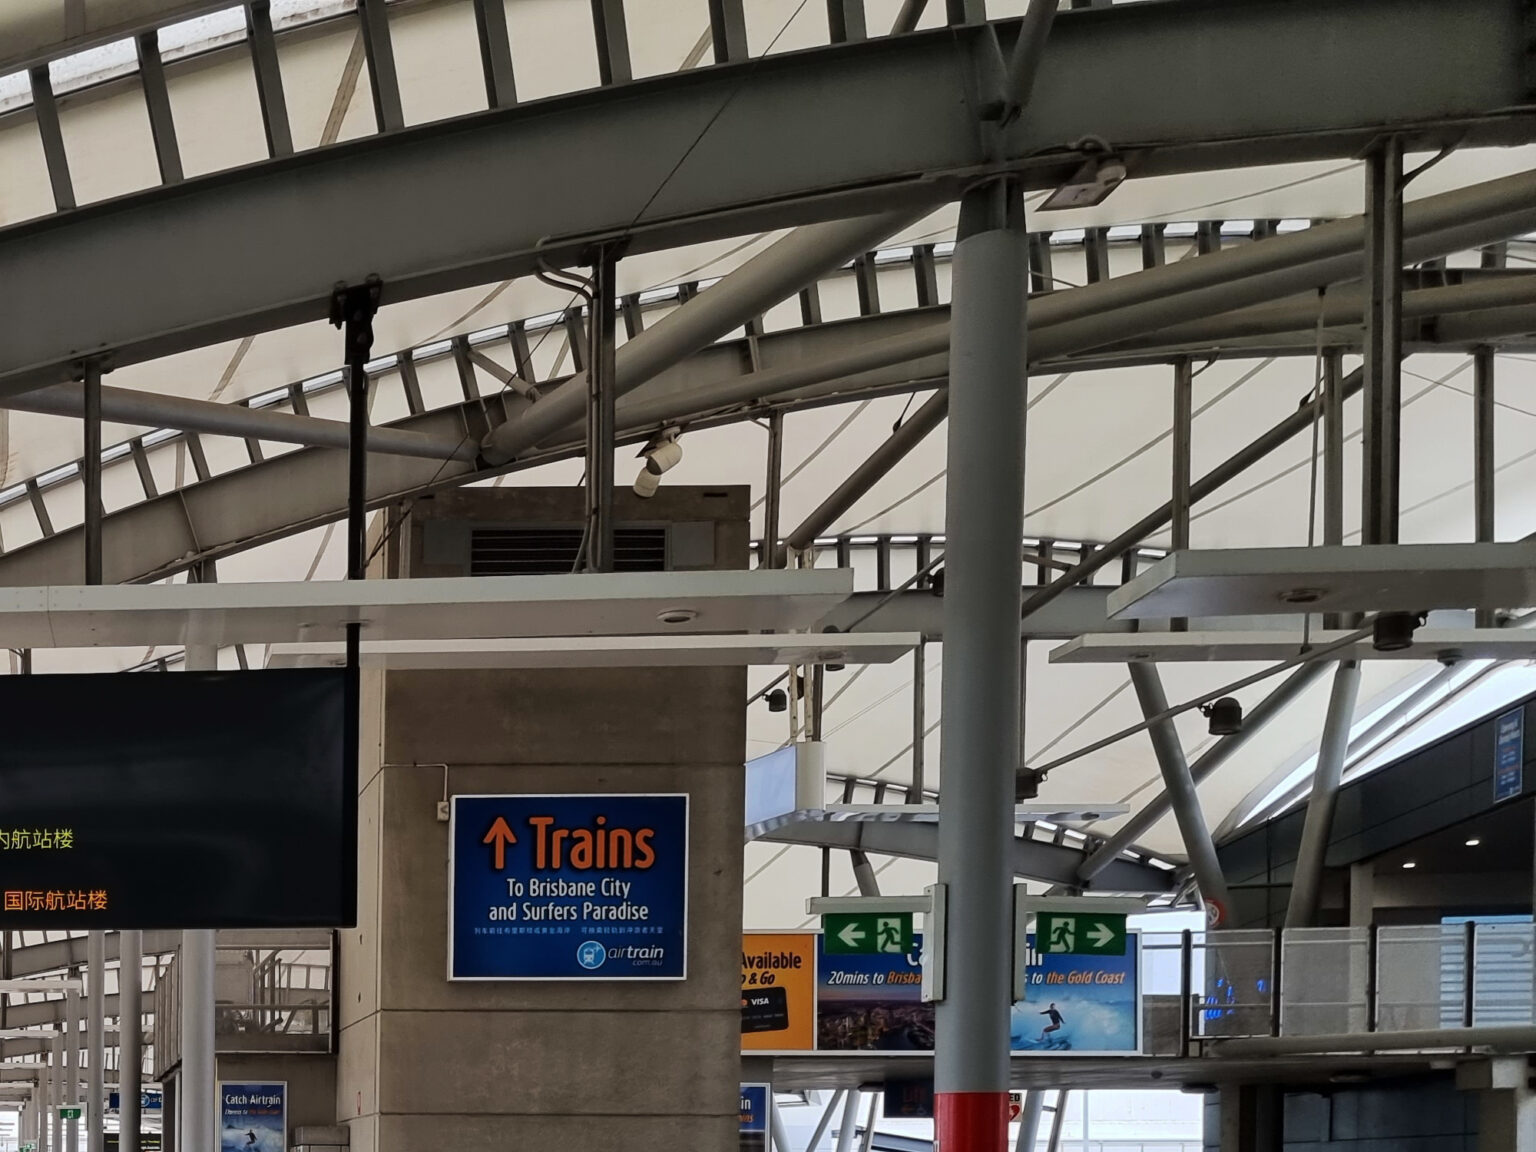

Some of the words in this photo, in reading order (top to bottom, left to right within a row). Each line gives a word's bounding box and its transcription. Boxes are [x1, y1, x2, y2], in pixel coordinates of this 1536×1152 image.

[529, 816, 655, 869] Trains
[507, 878, 523, 897] To
[529, 878, 595, 897] Brisbane
[601, 878, 631, 899] City
[4, 889, 108, 911] 国际航站楼
[489, 903, 516, 921] and
[522, 902, 577, 921] Surfers
[583, 901, 649, 920] Paradise
[608, 945, 664, 959] airtrain
[741, 952, 802, 969] Available
[748, 973, 758, 985] &
[760, 971, 775, 985] Go
[828, 971, 869, 985] 20mins
[873, 972, 884, 985] to
[887, 971, 922, 984] Brisba
[1031, 972, 1043, 985] to
[1046, 971, 1064, 985] the
[1067, 970, 1093, 985] Gold
[1095, 970, 1126, 985] Coast
[751, 998, 770, 1006] VISA
[225, 1094, 247, 1105] Catch
[250, 1094, 281, 1105] Airtrain
[1009, 1093, 1021, 1102] ED
